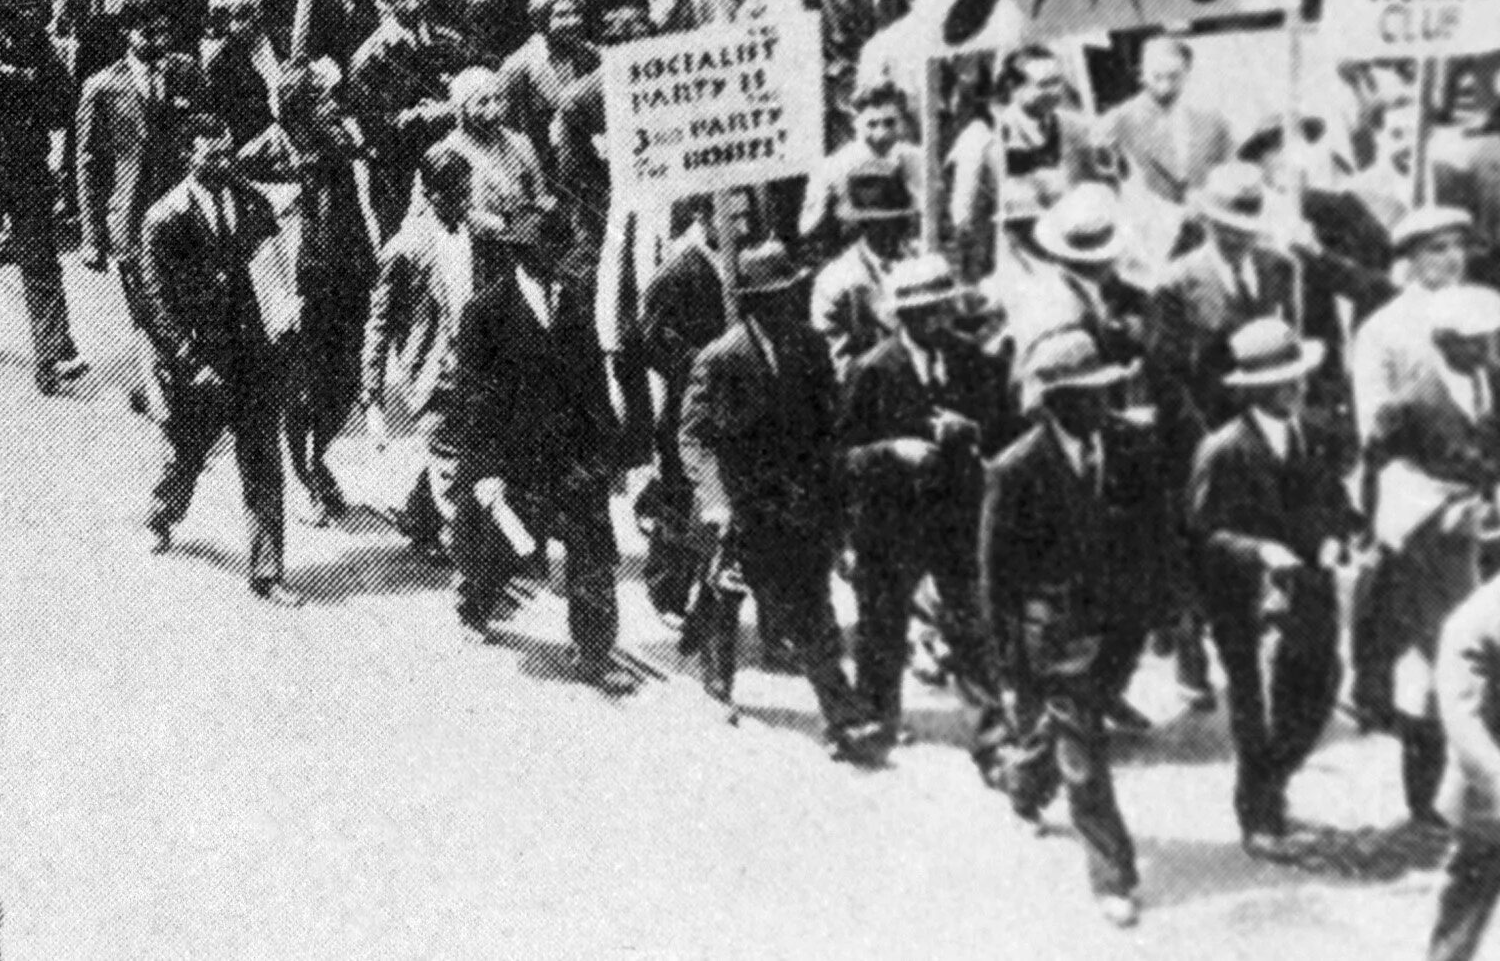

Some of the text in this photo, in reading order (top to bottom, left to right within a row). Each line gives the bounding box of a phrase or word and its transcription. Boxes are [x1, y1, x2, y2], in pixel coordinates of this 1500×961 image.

[629, 38, 780, 83] SOCIALIST
[632, 77, 726, 114] PARTY
[740, 68, 766, 93] IS
[690, 106, 784, 138] PARTY
[683, 129, 788, 172] BOSSES!
